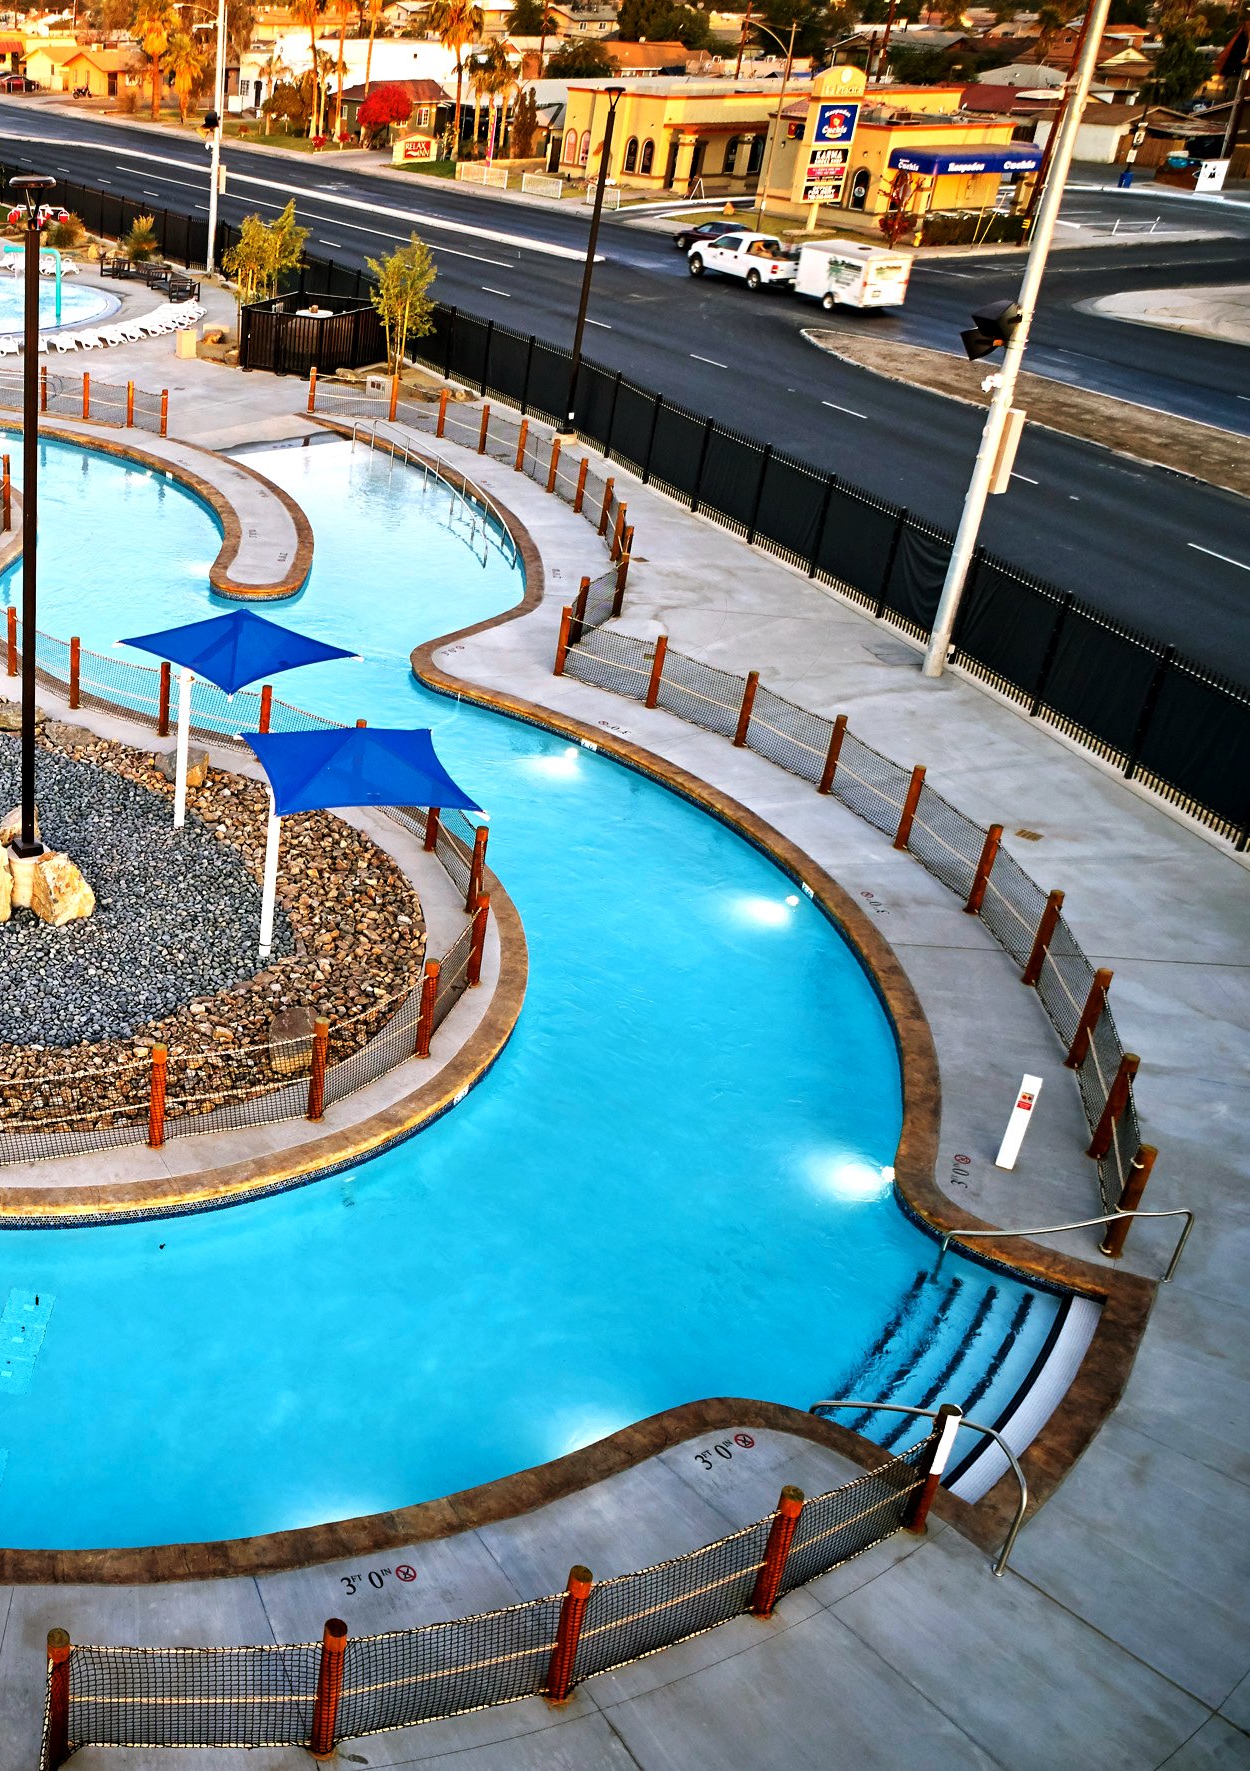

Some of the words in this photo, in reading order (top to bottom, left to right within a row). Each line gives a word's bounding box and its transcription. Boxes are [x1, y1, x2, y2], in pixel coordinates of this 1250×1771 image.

[405, 142, 426, 150] RELAX
[418, 149, 430, 157] INN
[816, 150, 842, 159] KARMA
